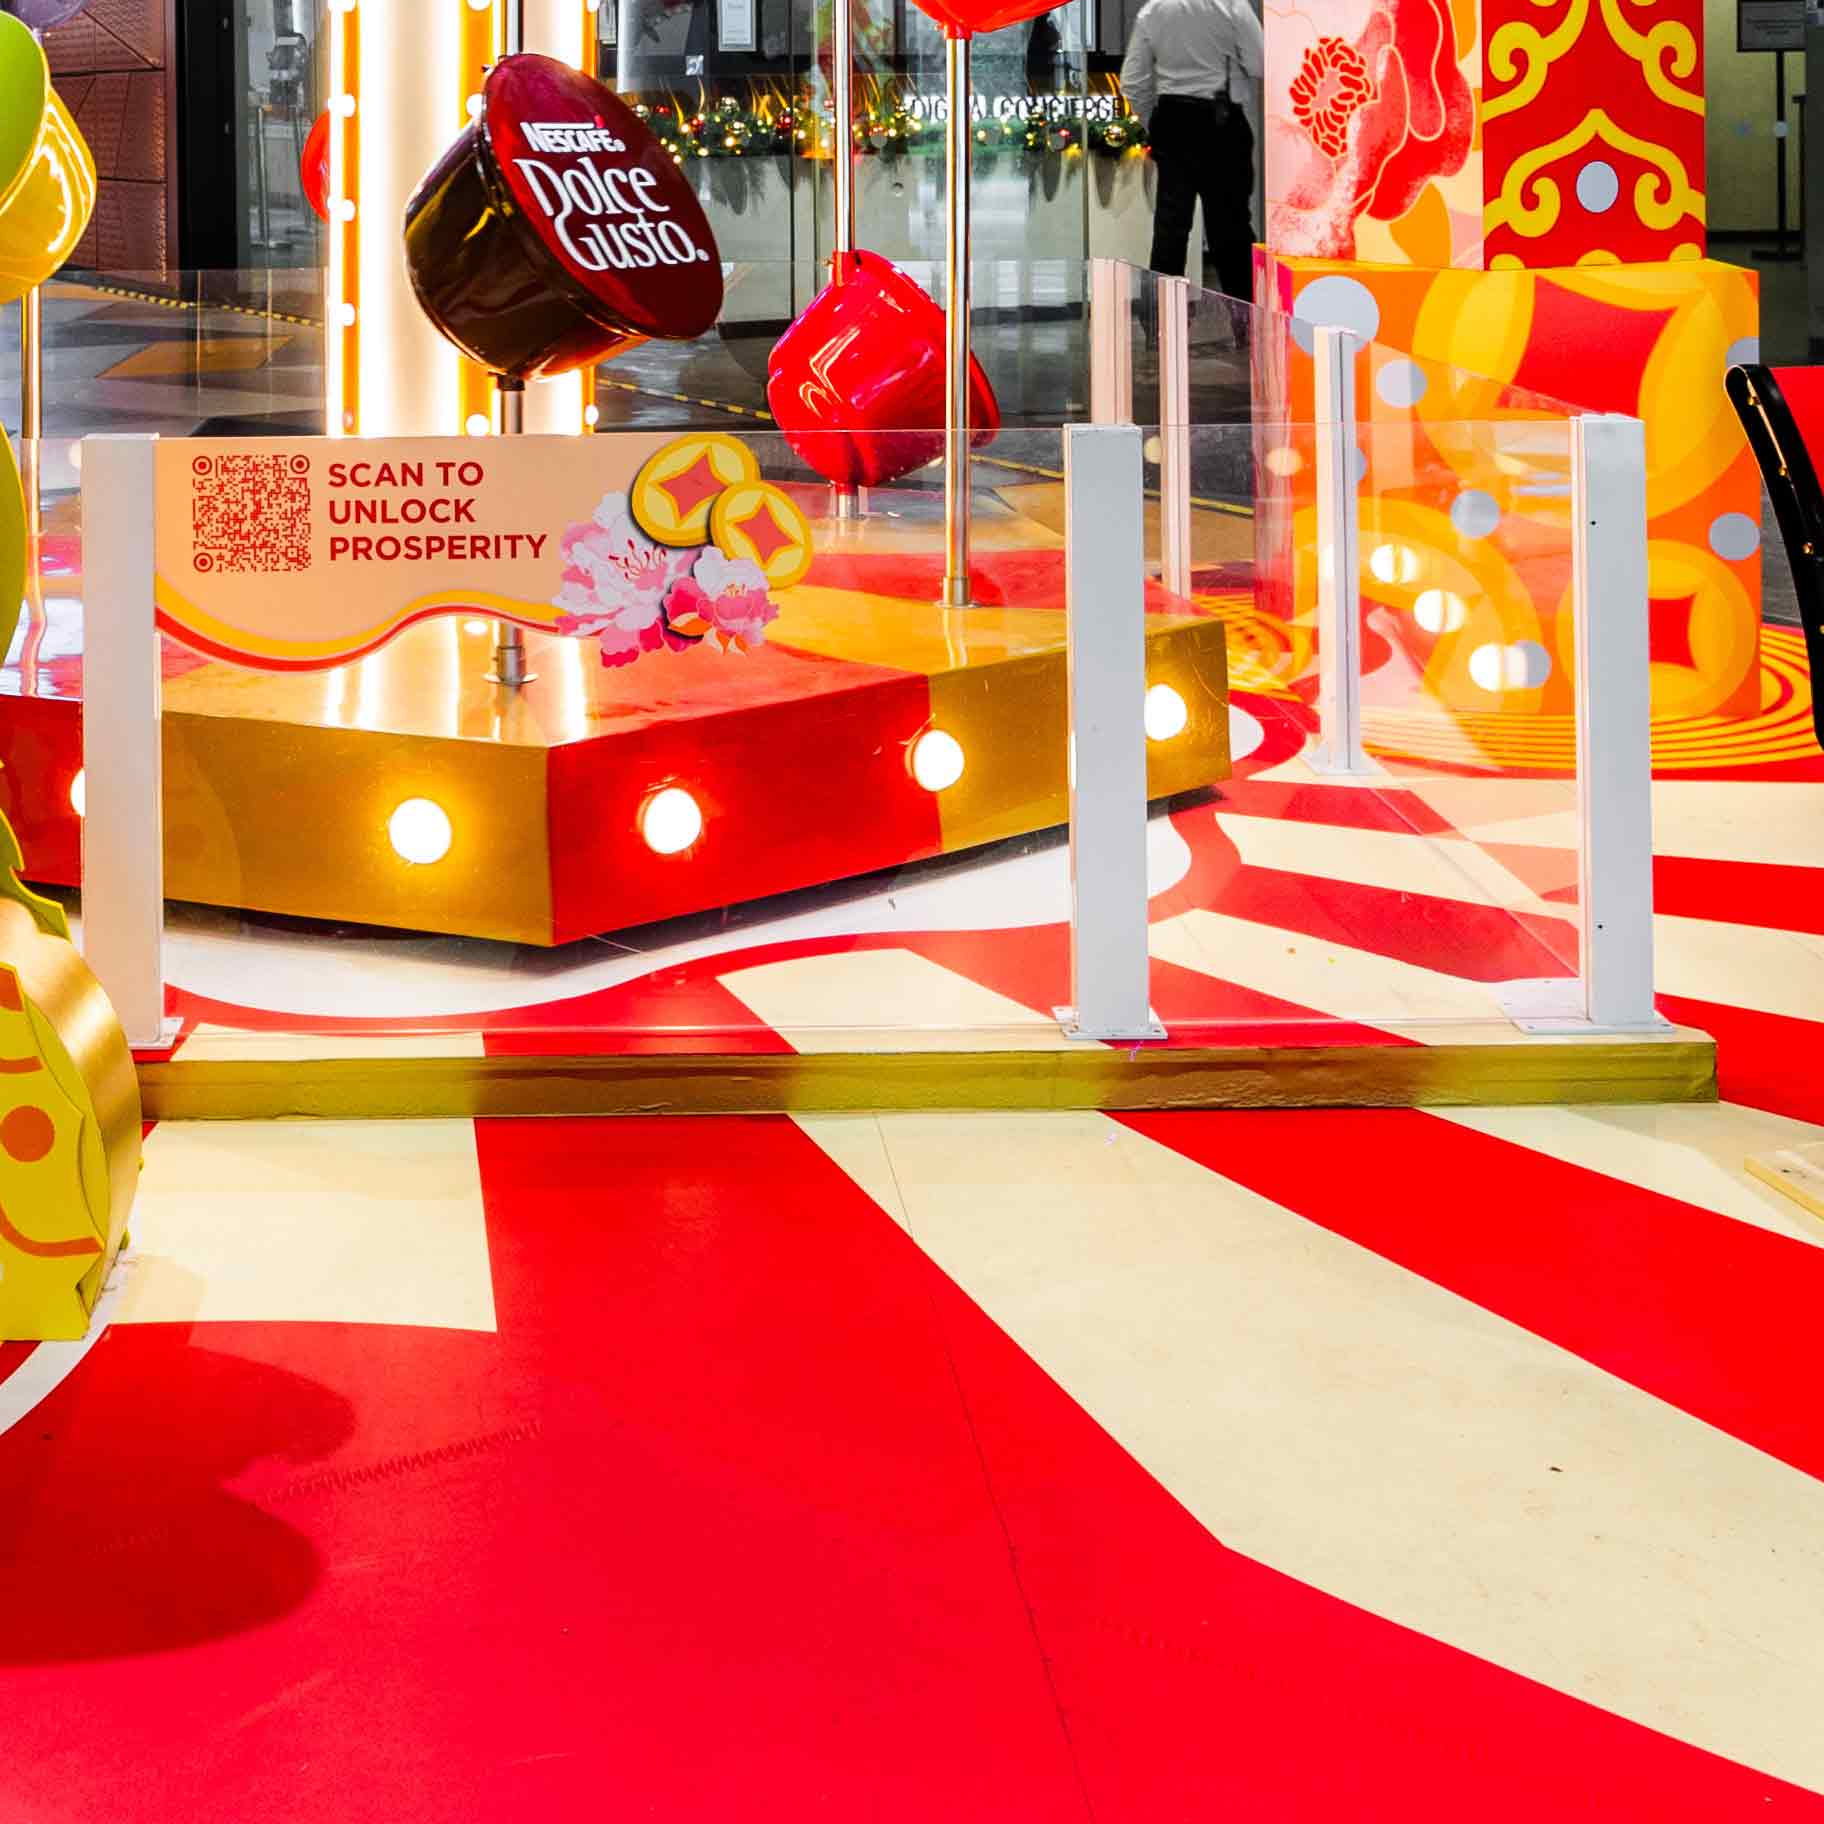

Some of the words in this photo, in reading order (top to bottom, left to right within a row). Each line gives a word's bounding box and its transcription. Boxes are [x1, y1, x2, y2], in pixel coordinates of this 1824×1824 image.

[513, 157, 670, 216] Dolce
[328, 462, 424, 488] SCAN
[436, 461, 484, 487] TO
[328, 498, 475, 524] UNLOCK
[329, 534, 547, 562] PROSPERITY
